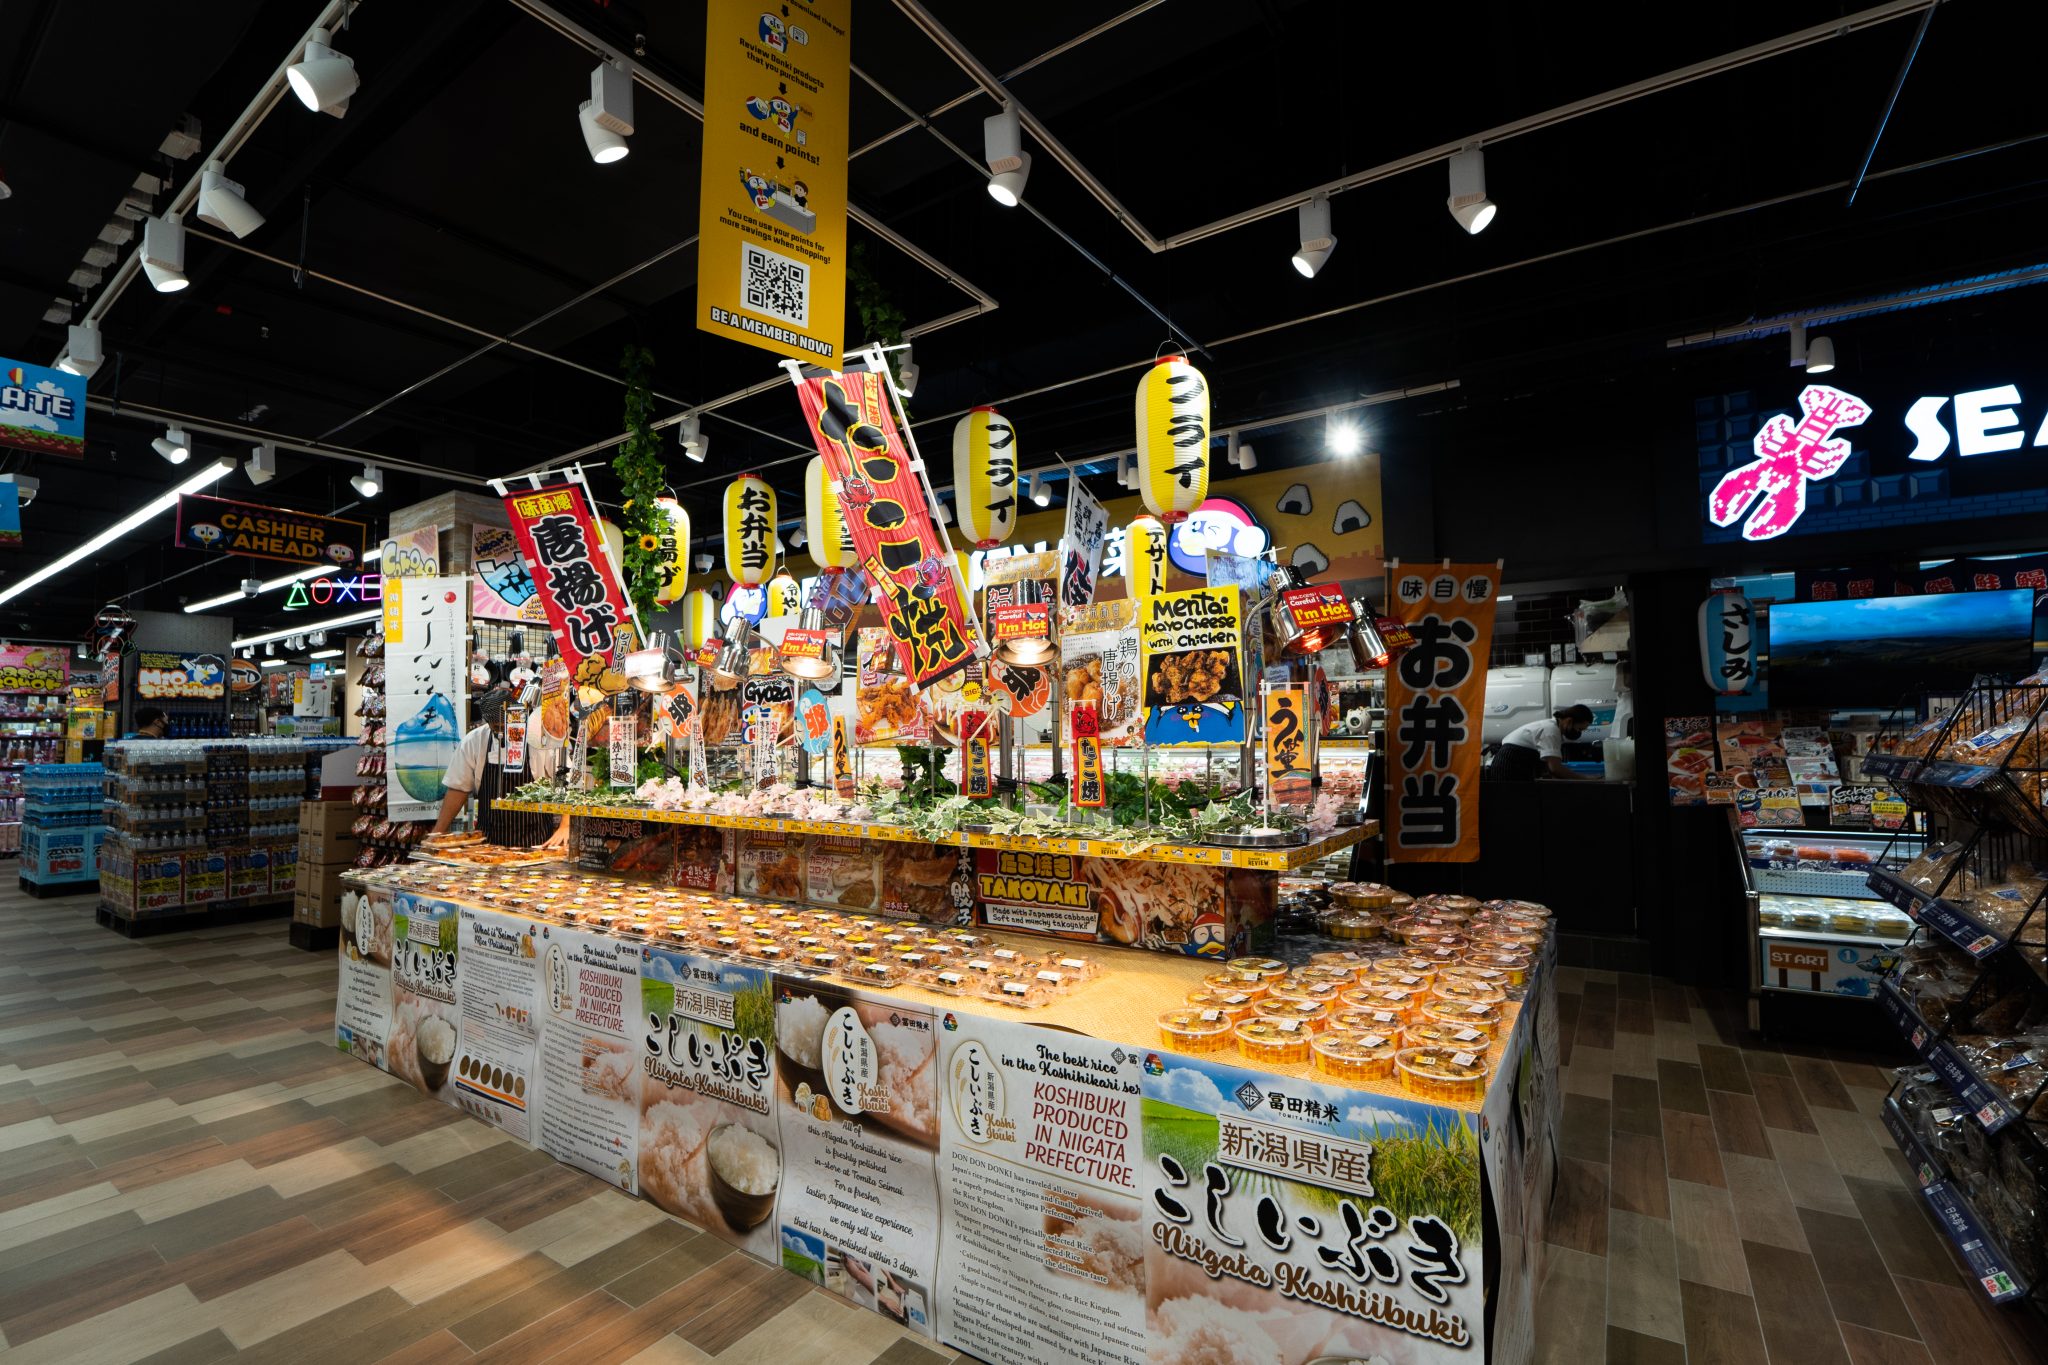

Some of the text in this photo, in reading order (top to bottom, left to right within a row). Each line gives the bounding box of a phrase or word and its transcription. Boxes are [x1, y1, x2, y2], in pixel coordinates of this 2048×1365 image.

[740, 37, 824, 88] Review Donki products
[747, 52, 818, 93] that you purchased
[740, 122, 820, 166] and earn points!
[720, 216, 830, 264] more savings when shopping!
[728, 208, 824, 252] You can use your points for
[711, 306, 833, 358] BE A MEMBER NOW!
[1165, 375, 1205, 488] フライ
[986, 423, 1015, 524] フライ
[220, 513, 324, 542] CASHIER
[738, 487, 772, 570] お弁当
[234, 534, 318, 559] AHEAD
[1145, 527, 1166, 595] デザート
[530, 515, 617, 656] 唐揚げ
[1402, 579, 1489, 600] 味自慢
[1154, 592, 1229, 620] Mentai
[1294, 602, 1348, 620] I'm Hot
[998, 621, 1046, 632] I'm Hot
[1149, 632, 1237, 648] WITH Chicken
[1398, 630, 1412, 640] Hot
[1720, 603, 1754, 680] さしみ
[784, 642, 821, 653] I'm Hot
[1120, 637, 1138, 678] 鶏の
[0, 667, 64, 680] asonal
[0, 676, 62, 690] quor
[1102, 648, 1121, 720] 唐揚げ
[744, 681, 792, 704] Gyoza
[1399, 616, 1477, 847] お弁当
[1832, 786, 1878, 798] Golden
[1000, 852, 1072, 879] たこ焼き
[980, 876, 1088, 907] TAKOYAKI
[474, 922, 490, 936] What
[992, 906, 1097, 922] Made with Japanese cabbage!
[992, 914, 1088, 930] Soft and munchy takoyaki!
[394, 940, 456, 988] こしいぶき
[583, 944, 593, 954] The
[584, 956, 618, 972] Koshihikari
[1772, 952, 1827, 966] START
[1844, 950, 1851, 960] 1
[580, 968, 622, 989] KOSHIIBUKI
[580, 982, 622, 1002] PRODUCED
[576, 1008, 624, 1032] PREFECTURE.
[591, 998, 620, 1017] NIIGATA
[676, 988, 733, 1022] 新潟県産
[646, 1013, 768, 1087] こしいぶき
[842, 1013, 855, 1106] こしいぶき
[1036, 1044, 1118, 1075] The best rice
[645, 1056, 768, 1112] Niigata Koshiibuki
[1002, 1054, 1120, 1091] in the Koshihikari
[857, 1083, 890, 1098] Koshi
[969, 1048, 982, 1136] こしいぶき
[1034, 1082, 1126, 1118] KOSHIBUKI
[842, 1120, 853, 1132] All
[984, 1113, 1016, 1130] Koshi
[986, 1128, 1016, 1142] Ibuki
[1033, 1102, 1128, 1140] PRODUCED
[808, 1125, 902, 1164] this Niigata Koshiibuki rice
[1035, 1124, 1126, 1162] IN NIIGATA
[1222, 1122, 1367, 1186] 新潟県産
[814, 1157, 904, 1196] in-store Tomita Seimai.
[832, 1148, 887, 1174] freshly polished
[952, 1152, 1052, 1190] DON DON DONKI has traveled
[1025, 1142, 1136, 1188] PREFECTURE.
[806, 1186, 914, 1238] tastier Japanese rice experience,
[854, 1186, 882, 1206] fresher,
[840, 1219, 884, 1242] only rice
[1154, 1155, 1464, 1301] こしいぶき
[794, 1216, 920, 1278] that has been polished within days.
[1152, 1221, 1467, 1344] Niigata Koshiibuki
